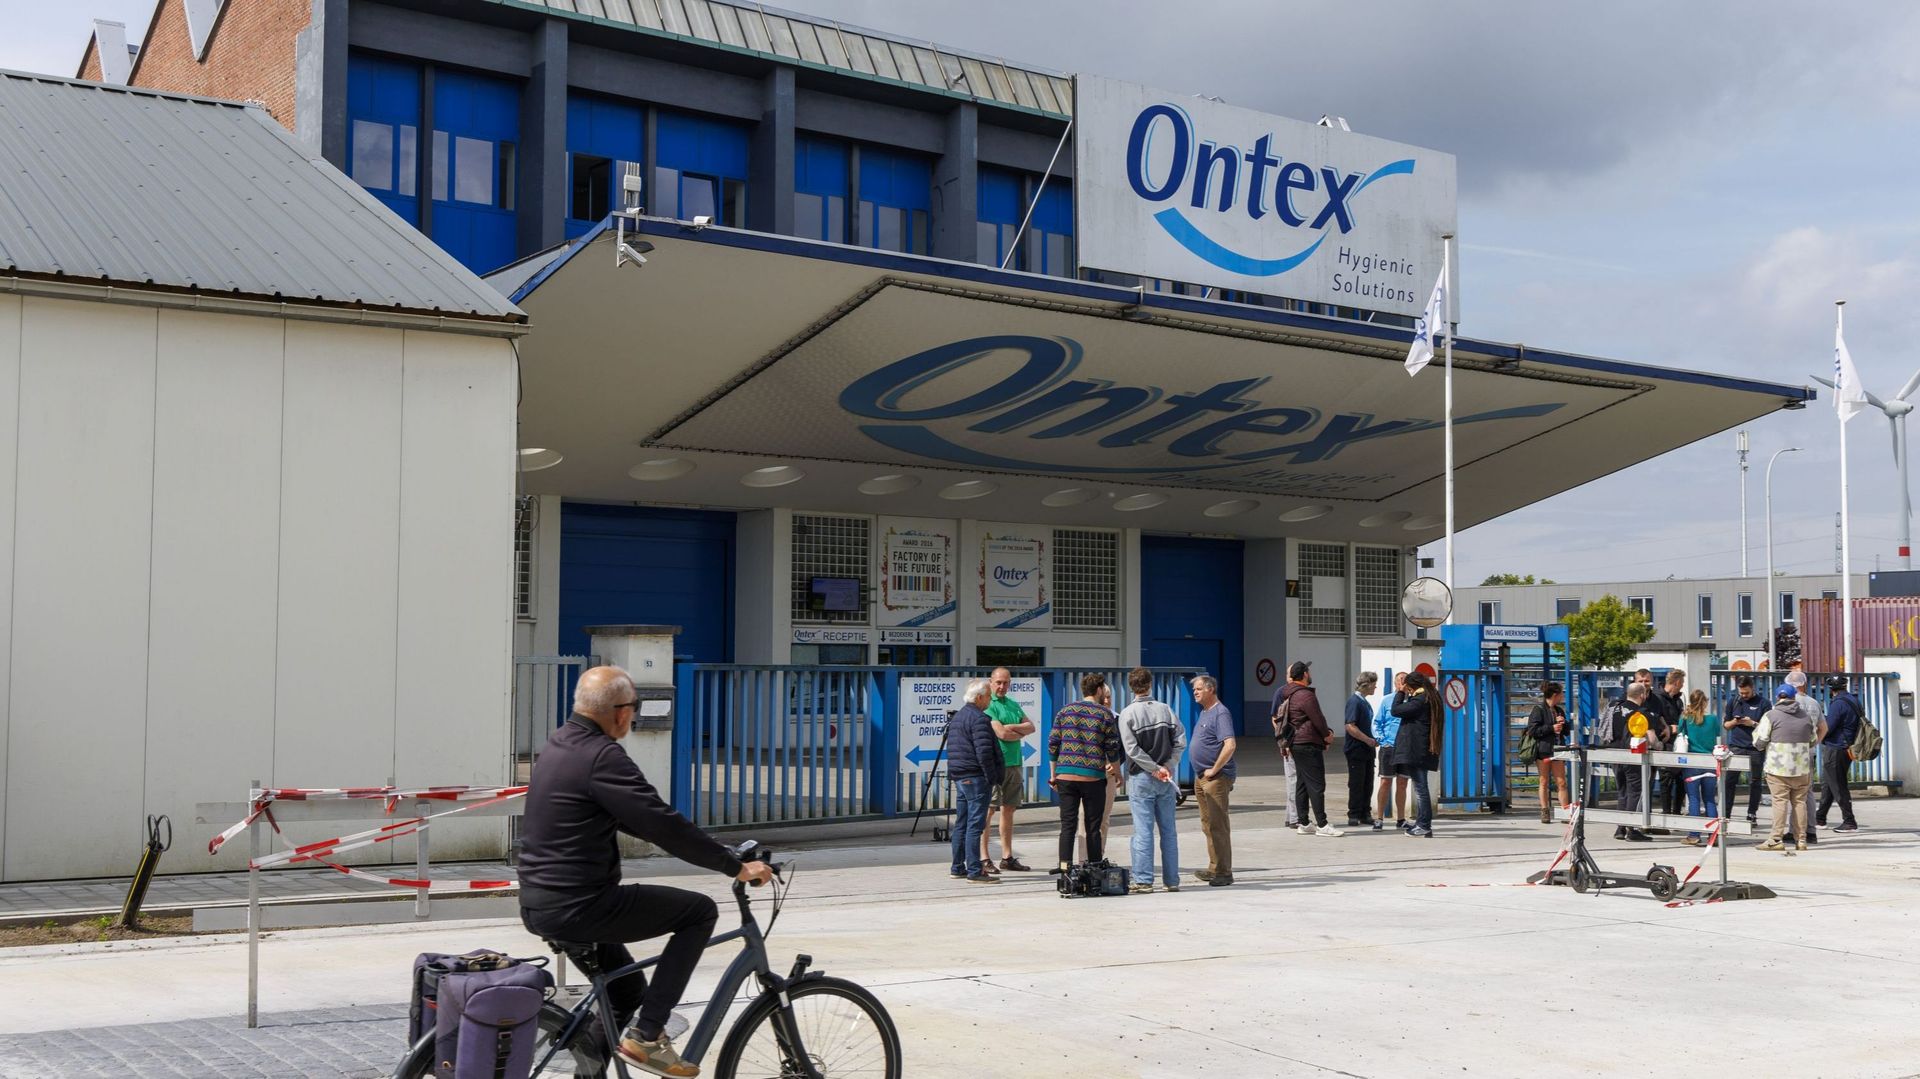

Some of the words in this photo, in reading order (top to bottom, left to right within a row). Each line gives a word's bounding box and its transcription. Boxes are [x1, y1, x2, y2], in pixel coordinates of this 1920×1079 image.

[1126, 102, 1366, 235] Ontex
[1338, 246, 1414, 276] Hygienic
[1332, 273, 1415, 303] Solutions
[838, 334, 1432, 465] Ontex
[893, 551, 929, 562] FACTORY
[931, 552, 942, 563] OF
[892, 562, 908, 573] THE
[911, 563, 942, 574] FUTURE
[993, 565, 1029, 581] Ontex
[1288, 581, 1296, 596] 7
[794, 629, 816, 639] Ontex
[823, 631, 867, 642] RECEPTIE
[1485, 629, 1504, 637] INGANG
[1504, 630, 1538, 638] WERKNEMERS
[913, 683, 956, 693] BEZOEKERS
[918, 695, 952, 705] VISITORS
